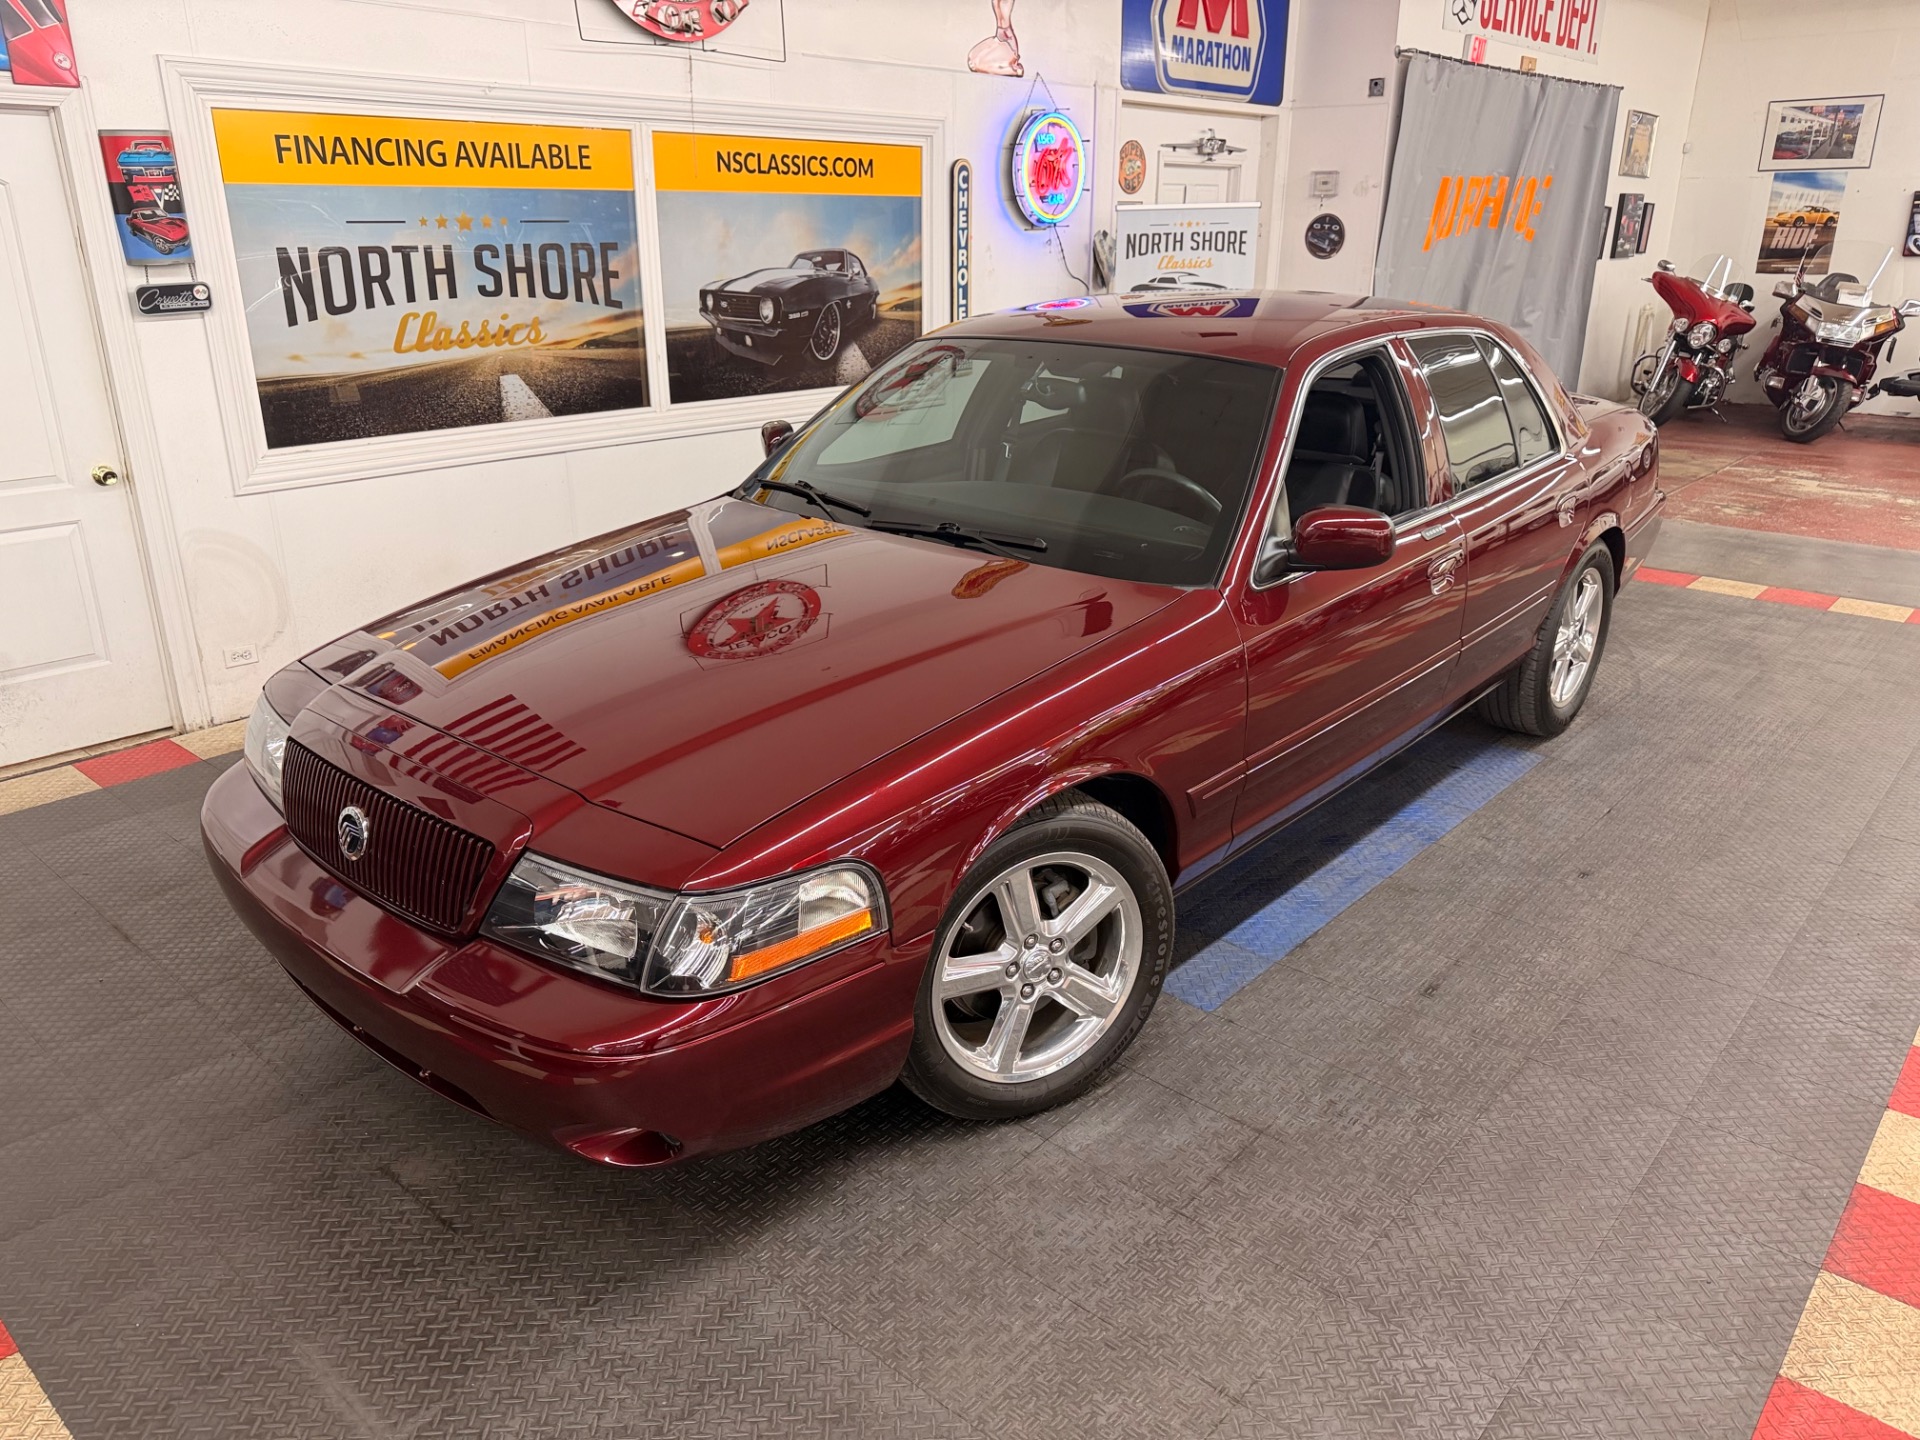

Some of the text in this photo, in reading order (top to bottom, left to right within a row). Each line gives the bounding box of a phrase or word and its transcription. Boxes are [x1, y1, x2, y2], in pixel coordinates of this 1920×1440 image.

[1171, 34, 1252, 72] MARATHON
[274, 133, 592, 170] FINANCING AVAILABLE
[716, 150, 875, 179] NSCLASSICS.COM
[1119, 143, 1145, 164] SUPER
[1123, 172, 1142, 192] BEE
[1313, 222, 1340, 231] GTO
[1769, 226, 1819, 251] RIDE
[957, 170, 969, 321] CHEVROLE
[1125, 229, 1248, 260] NORTH SHORE
[1157, 255, 1214, 271] Classics
[275, 241, 624, 328] NORTH SHORE
[139, 288, 196, 311] Corvette
[392, 310, 548, 354] Classics
